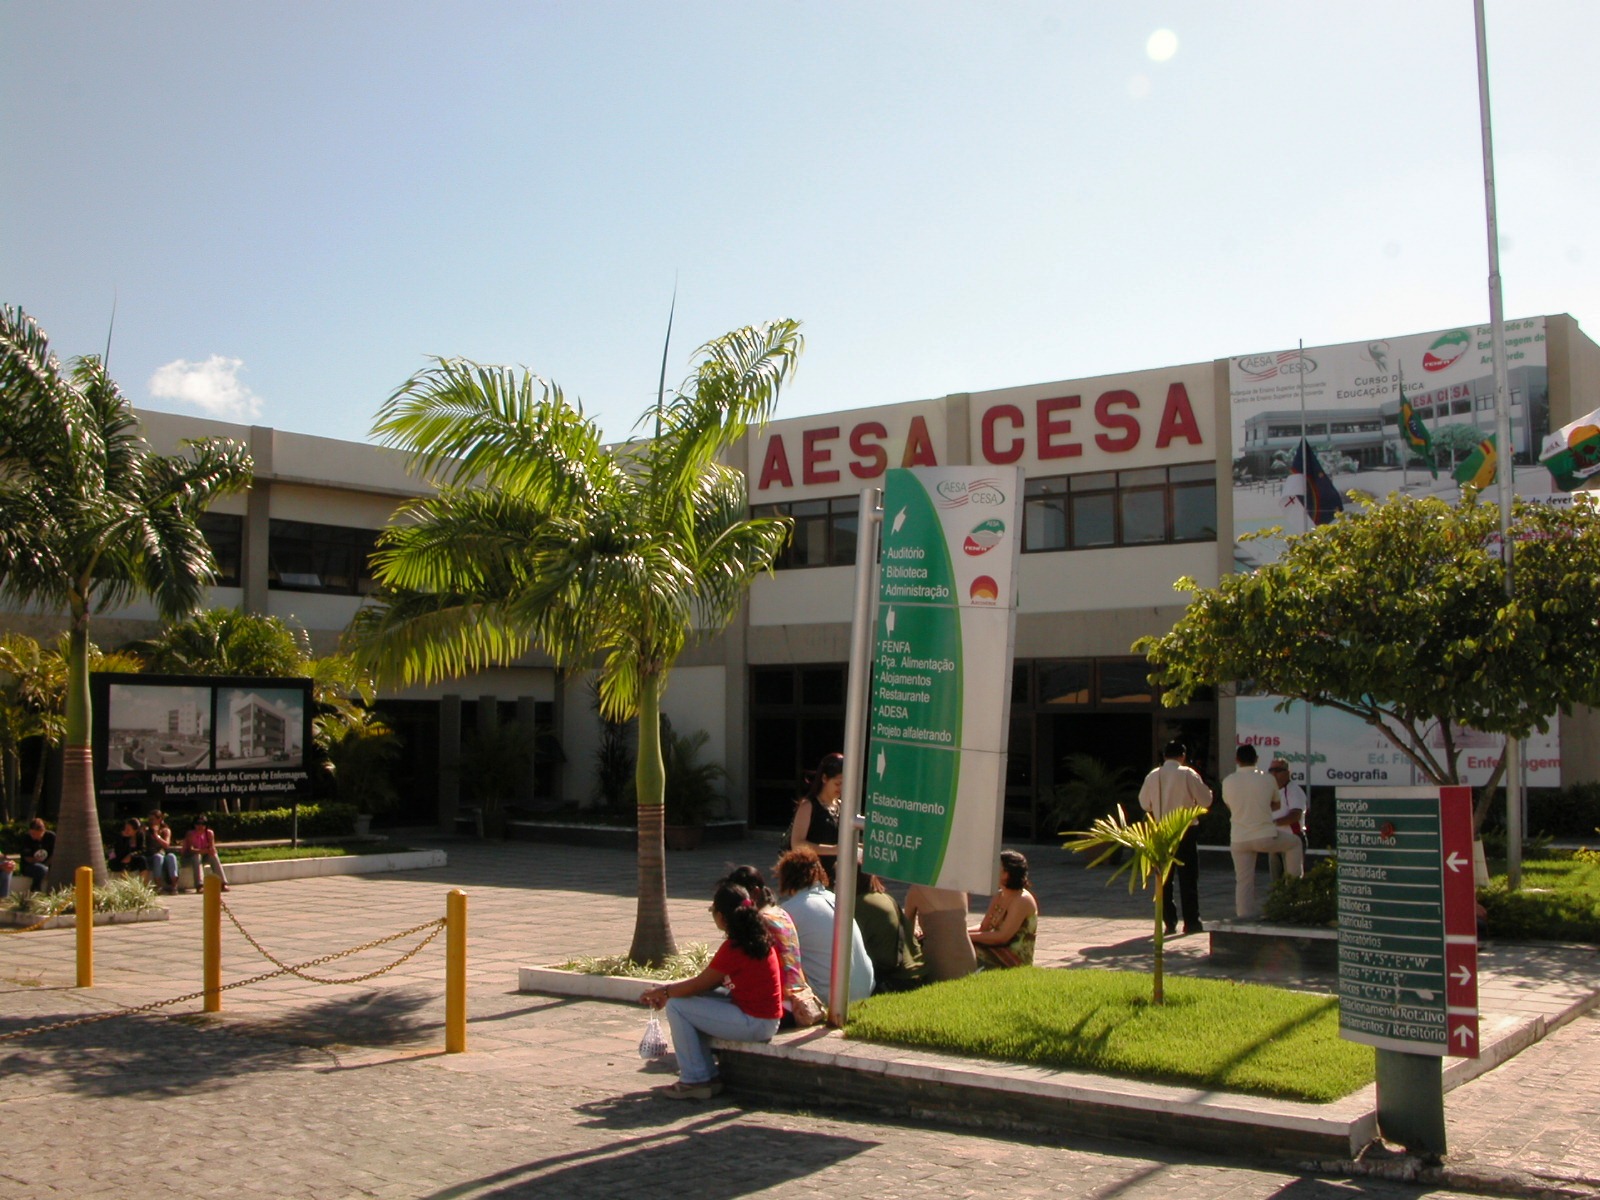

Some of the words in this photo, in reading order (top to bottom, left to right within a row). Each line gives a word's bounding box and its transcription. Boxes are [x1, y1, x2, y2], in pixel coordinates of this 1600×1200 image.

[1477, 322, 1521, 336] Facade
[1246, 356, 1273, 368] AESA
[1279, 362, 1310, 375] CESA
[1411, 393, 1433, 408] ESA
[758, 415, 938, 490] AESA
[981, 382, 1203, 465] CESA
[943, 481, 967, 493] AESA
[971, 493, 998, 504] CESA
[887, 547, 925, 560] Auditório
[886, 566, 928, 579] Biblioteca
[885, 584, 949, 600] Administração
[882, 641, 911, 653] FENFA
[901, 656, 955, 673] Alimentação
[880, 672, 932, 686] Alojamentos
[879, 687, 931, 703] Restaurante
[879, 705, 909, 719] ADESA
[877, 723, 901, 738] Projeto
[1236, 733, 1280, 746] Letras
[1327, 768, 1388, 781] Geografia
[872, 792, 945, 815] Estacionamento
[871, 811, 899, 827] Blocos
